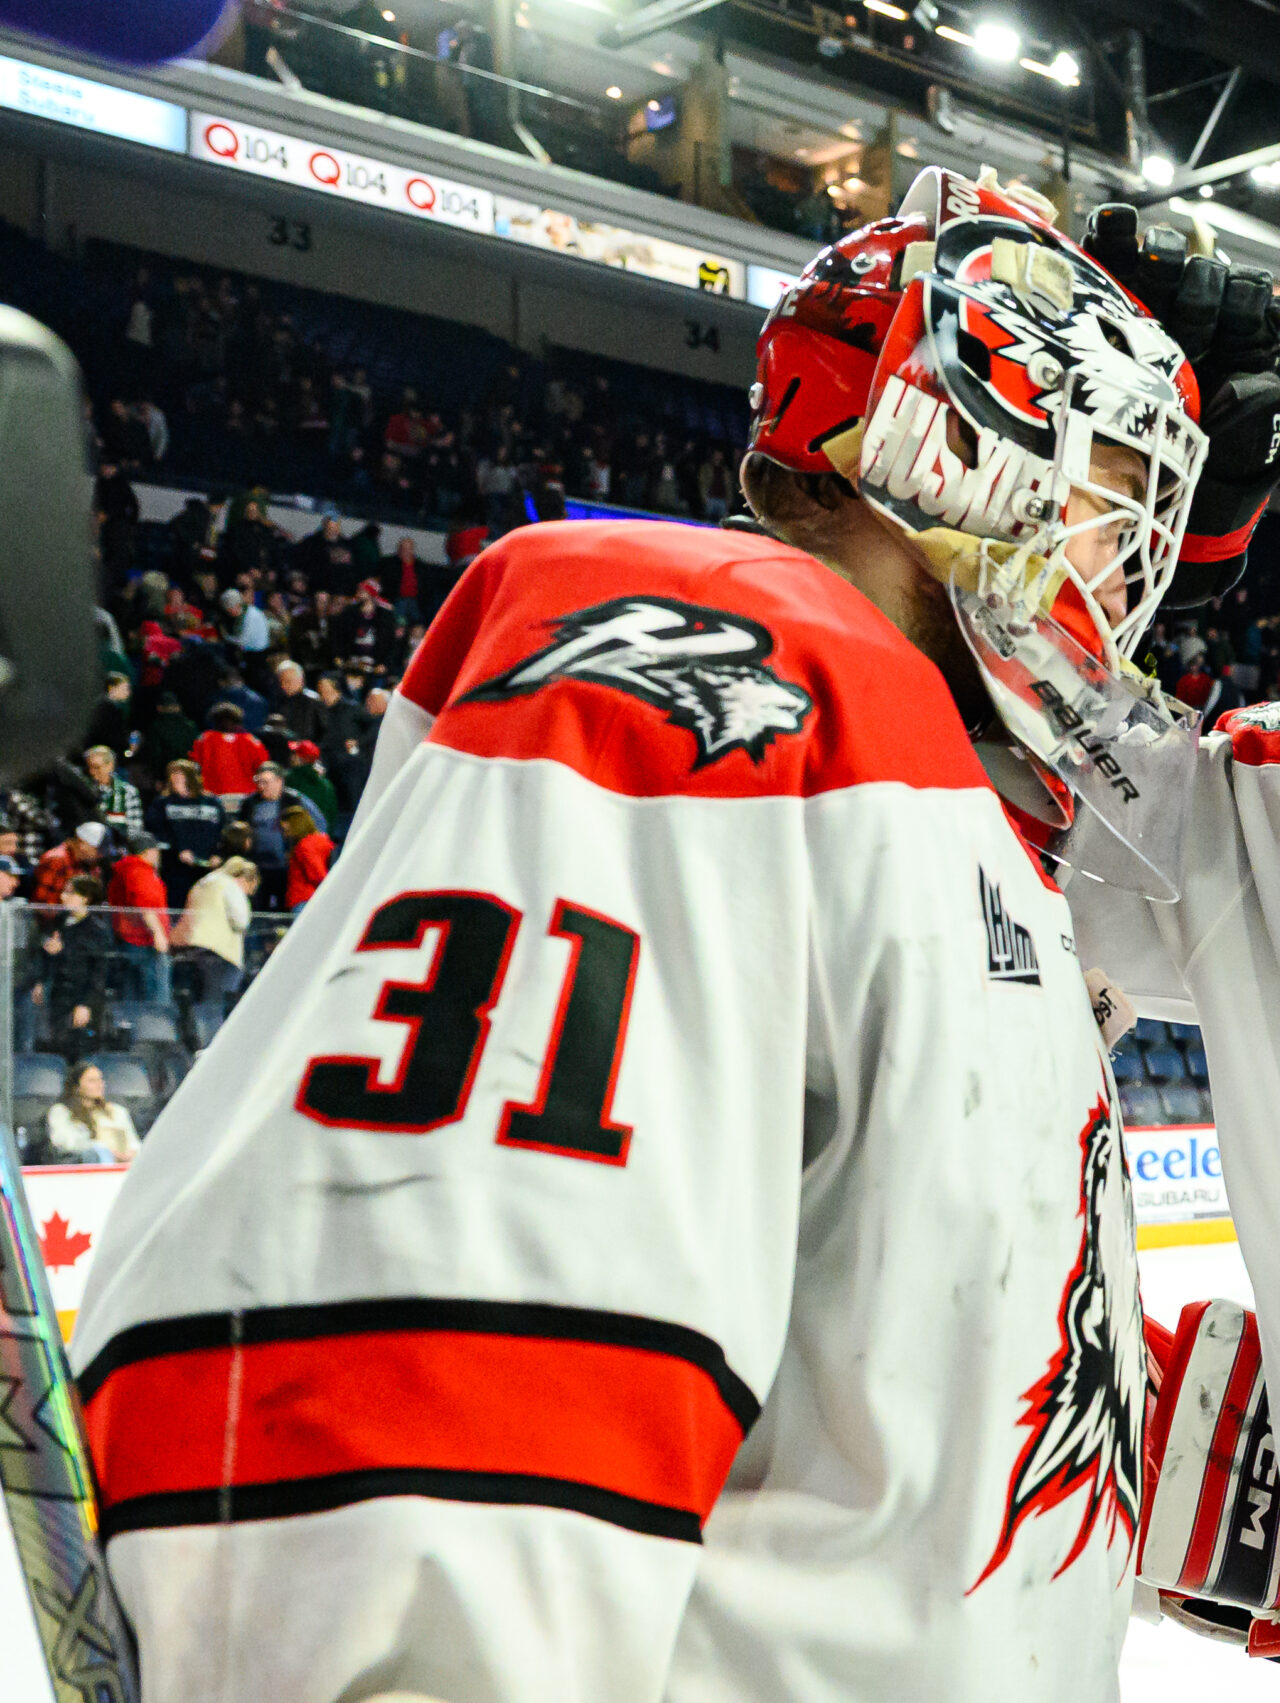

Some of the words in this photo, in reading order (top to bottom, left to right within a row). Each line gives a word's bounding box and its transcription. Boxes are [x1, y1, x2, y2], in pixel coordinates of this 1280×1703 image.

[268, 214, 312, 250] 33
[686, 318, 721, 351] 34
[1030, 680, 1140, 804] BAUER
[295, 889, 640, 1168] 31
[1127, 1137, 1222, 1181] eele
[1137, 1188, 1219, 1207] SUBARU
[1239, 1430, 1279, 1550] CM
